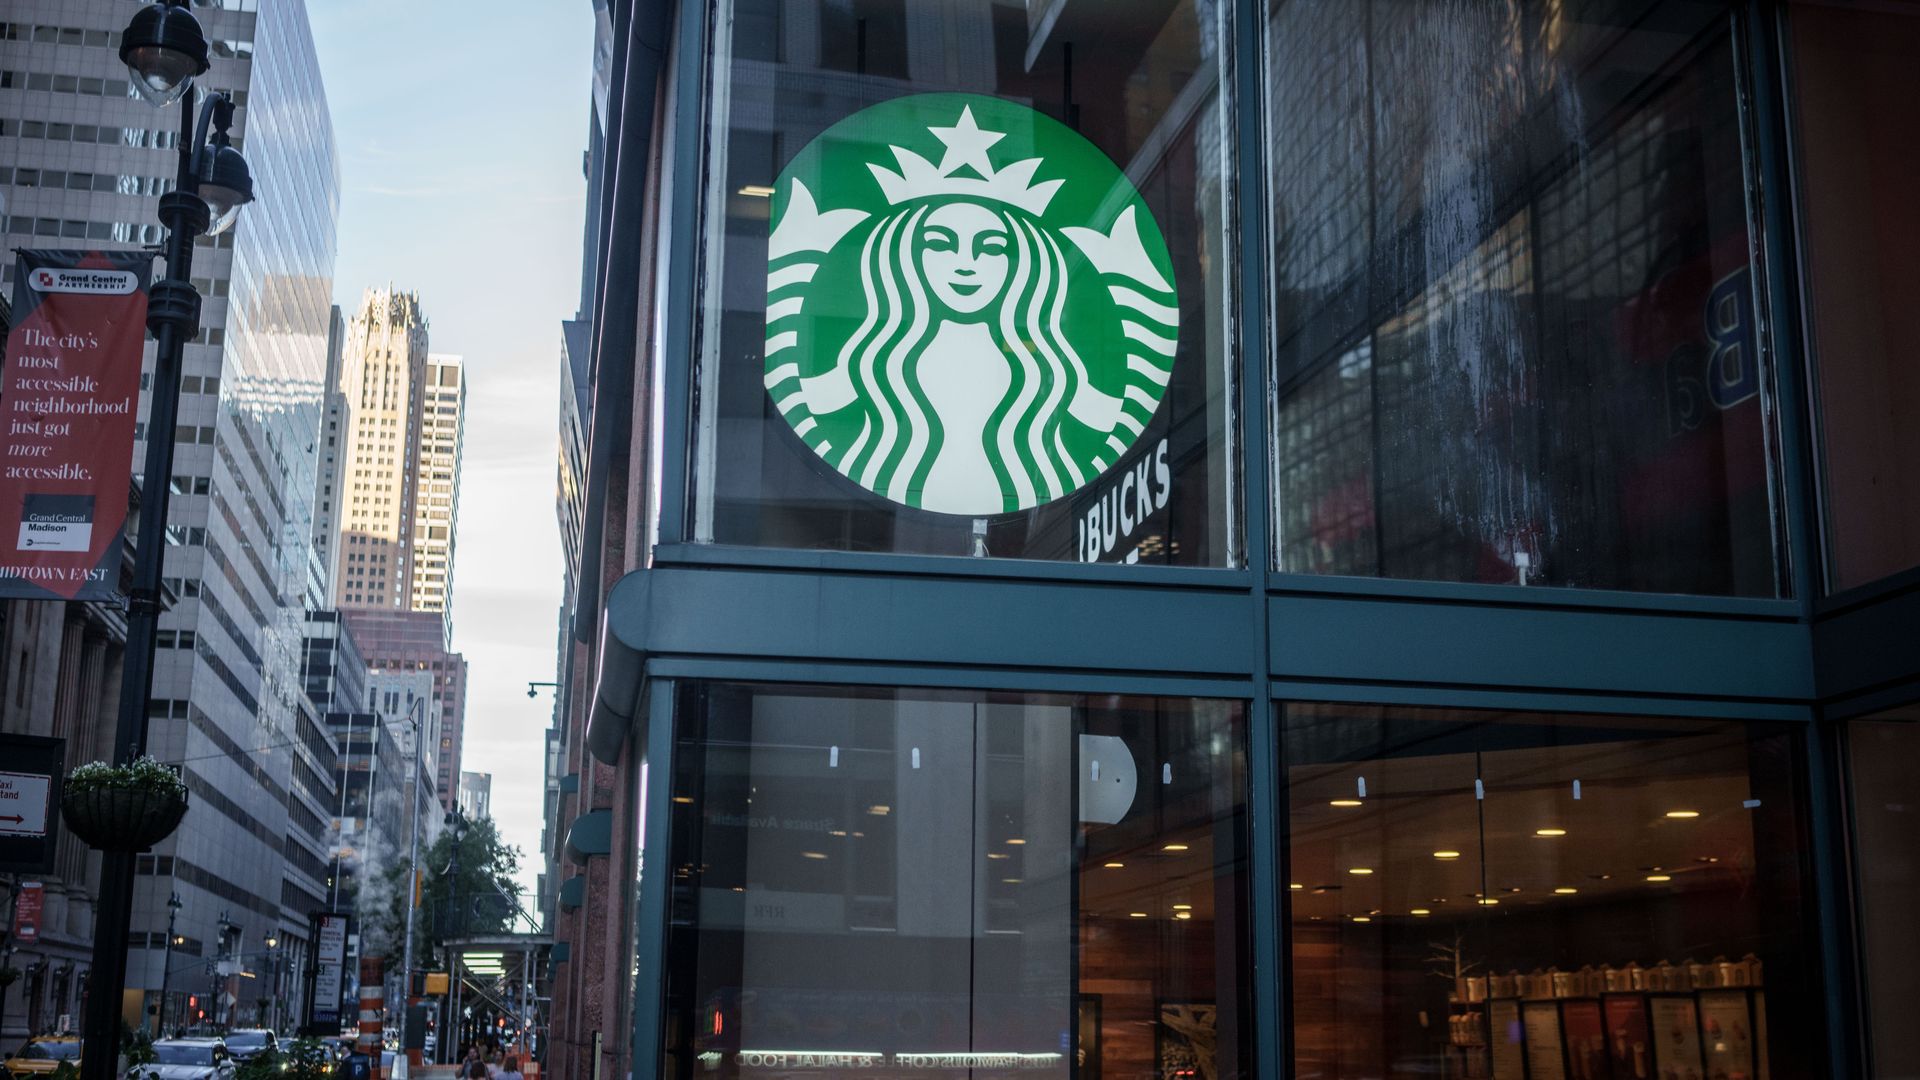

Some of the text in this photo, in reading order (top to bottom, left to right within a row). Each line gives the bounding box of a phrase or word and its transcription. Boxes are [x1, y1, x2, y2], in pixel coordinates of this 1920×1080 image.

[59, 274, 127, 284] Grand Central
[22, 328, 98, 351] The city's
[18, 356, 60, 369] most
[16, 375, 99, 392] accessible
[13, 397, 130, 415] neighborhood
[9, 418, 71, 437] just got
[8, 444, 52, 457] more
[6, 463, 92, 481] accessible.
[29, 513, 86, 522] Grand Central
[28, 523, 67, 532] Madison
[70, 568, 108, 582] EAST
[0, 780, 13, 790] axi
[0, 790, 19, 800] tand
